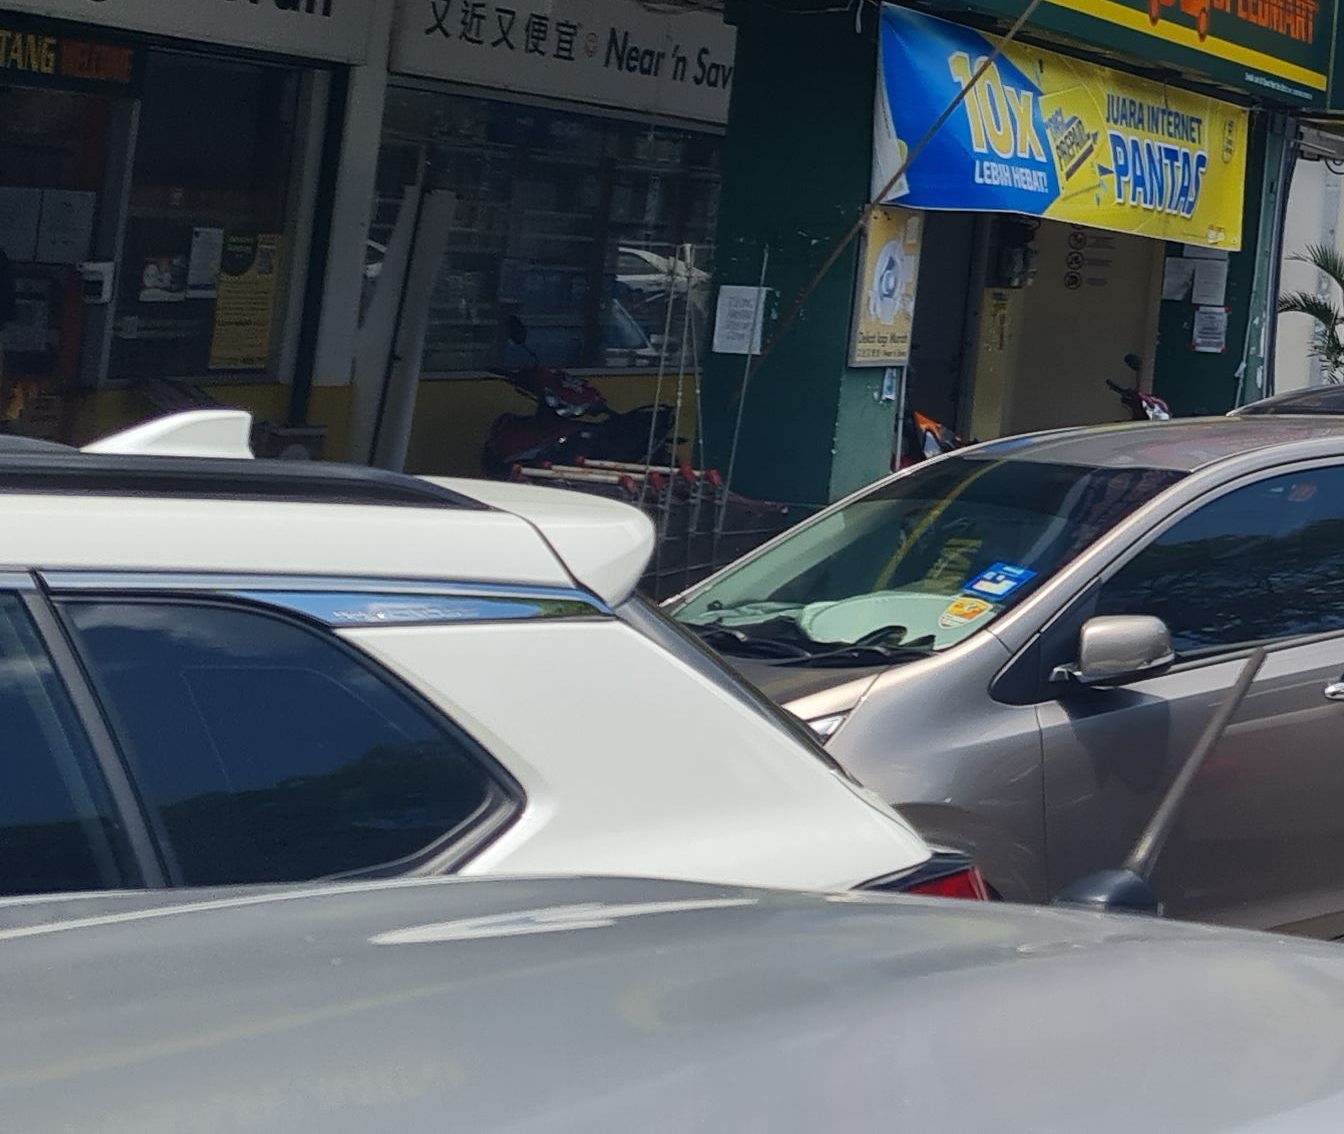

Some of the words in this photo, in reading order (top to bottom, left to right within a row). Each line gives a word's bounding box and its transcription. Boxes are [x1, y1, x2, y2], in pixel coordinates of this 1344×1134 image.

[604, 27, 665, 77] Near
[948, 51, 1048, 163] 10X
[1106, 94, 1145, 131] JUARA
[1147, 105, 1202, 145] INTERNET
